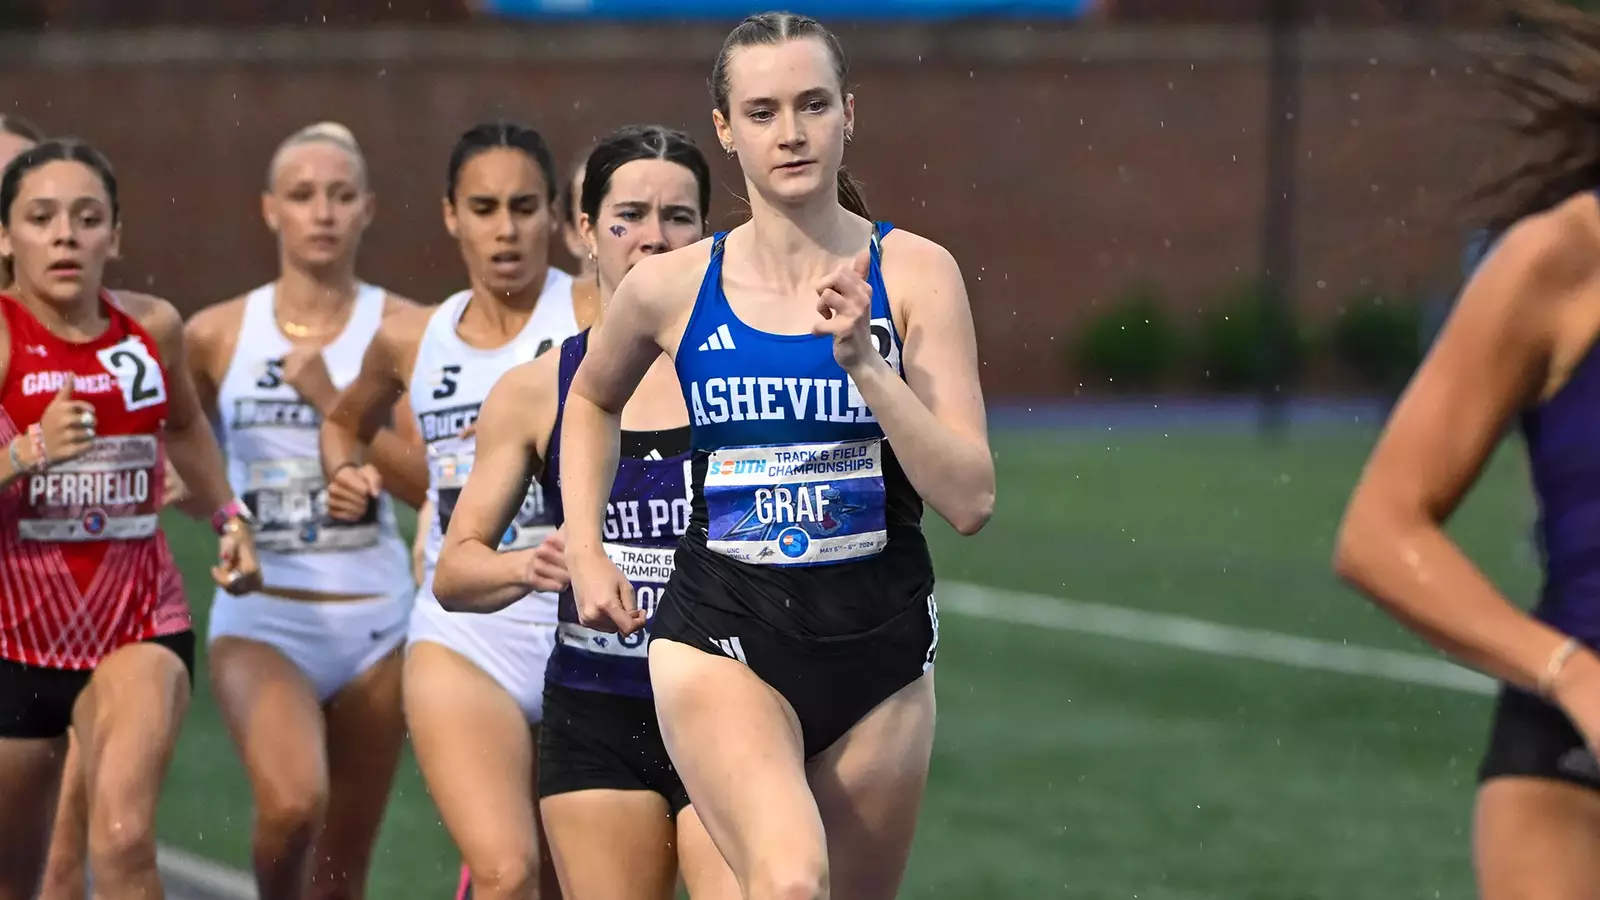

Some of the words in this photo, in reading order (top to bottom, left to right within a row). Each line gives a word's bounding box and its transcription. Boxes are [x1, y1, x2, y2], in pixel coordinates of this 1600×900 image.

[110, 350, 159, 403] 2
[775, 450, 817, 464] TRACK
[822, 449, 831, 461] &
[834, 446, 867, 458] FIELD
[709, 459, 766, 476] SOUTH
[768, 458, 874, 478] CHAMPIONSHIPS
[29, 468, 149, 507] PERRIELLO
[755, 484, 831, 525] GRAF
[621, 550, 661, 565] TRACK
[664, 554, 673, 566] &
